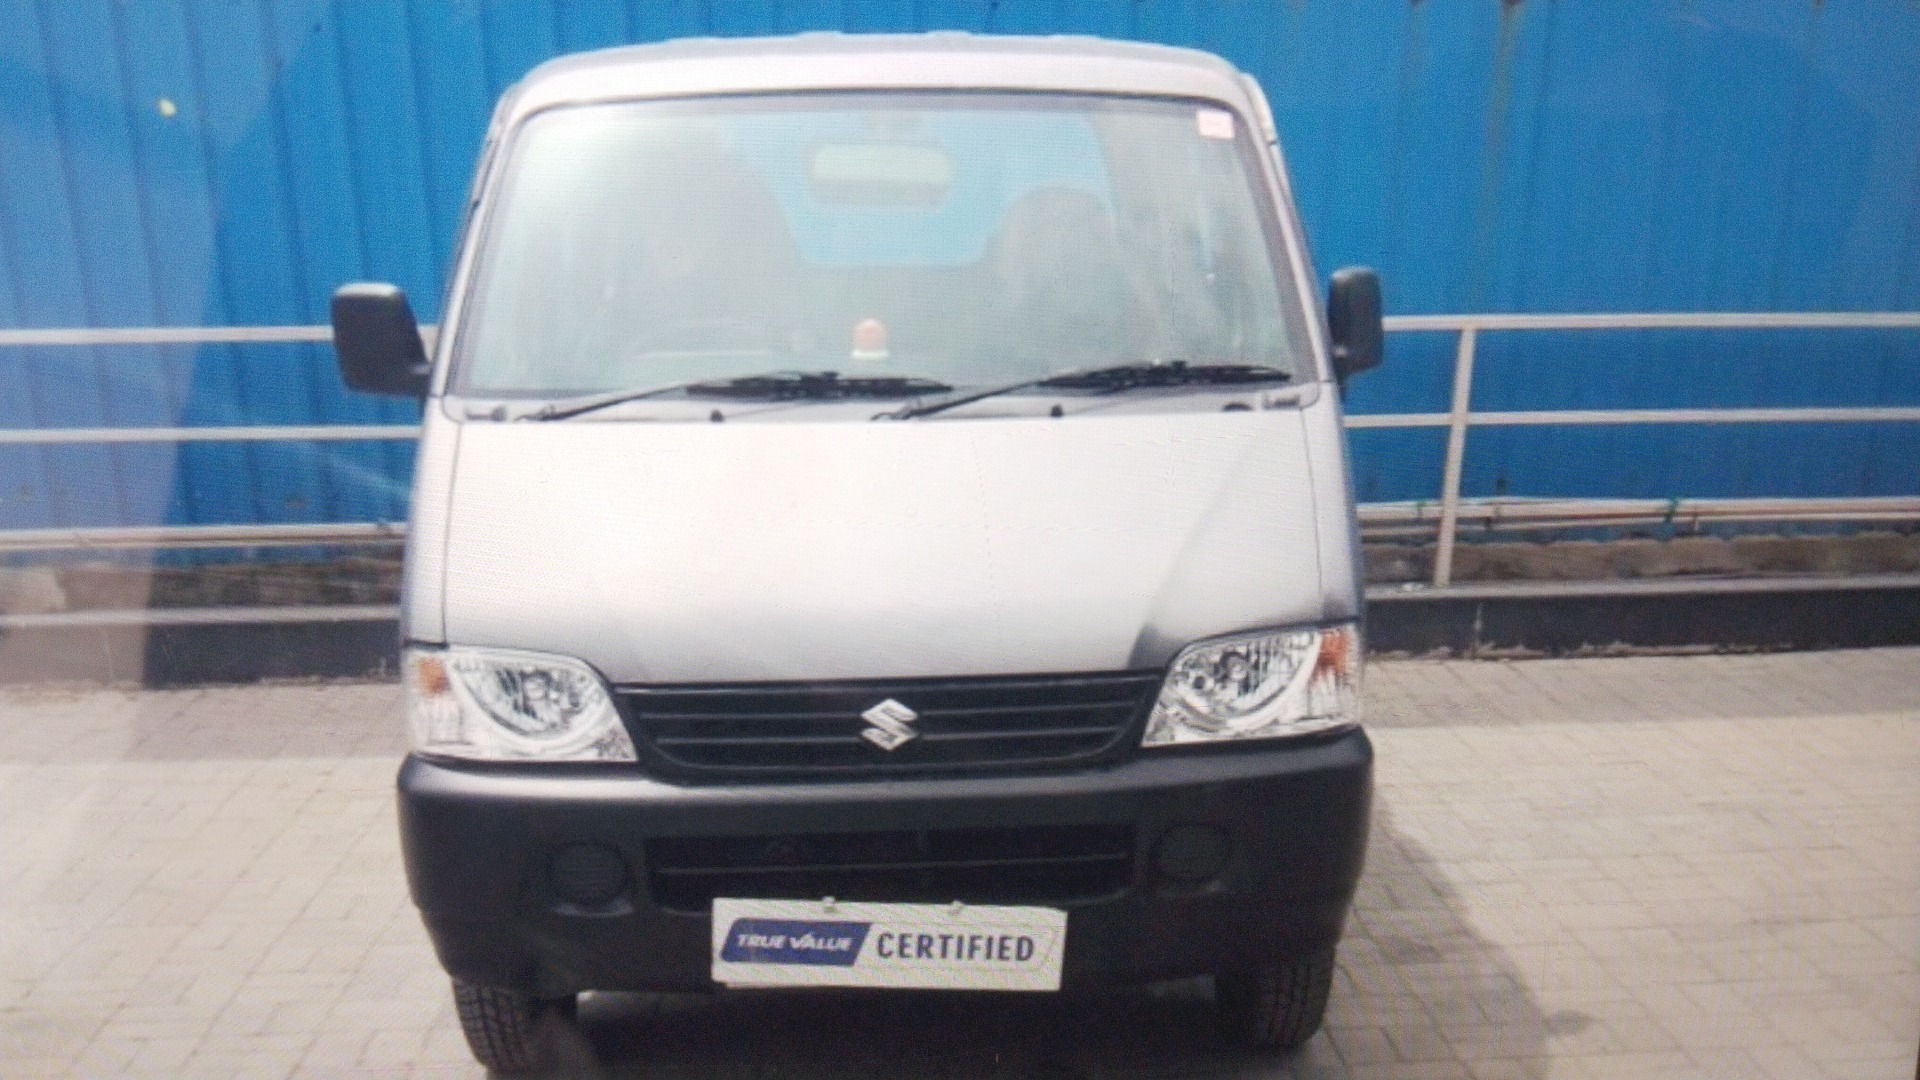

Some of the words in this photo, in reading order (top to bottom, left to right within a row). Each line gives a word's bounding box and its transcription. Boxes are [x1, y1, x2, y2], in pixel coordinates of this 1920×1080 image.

[738, 933, 785, 949] TRUE
[790, 932, 854, 951] VALUE
[876, 932, 1035, 962] CERTIFIED
